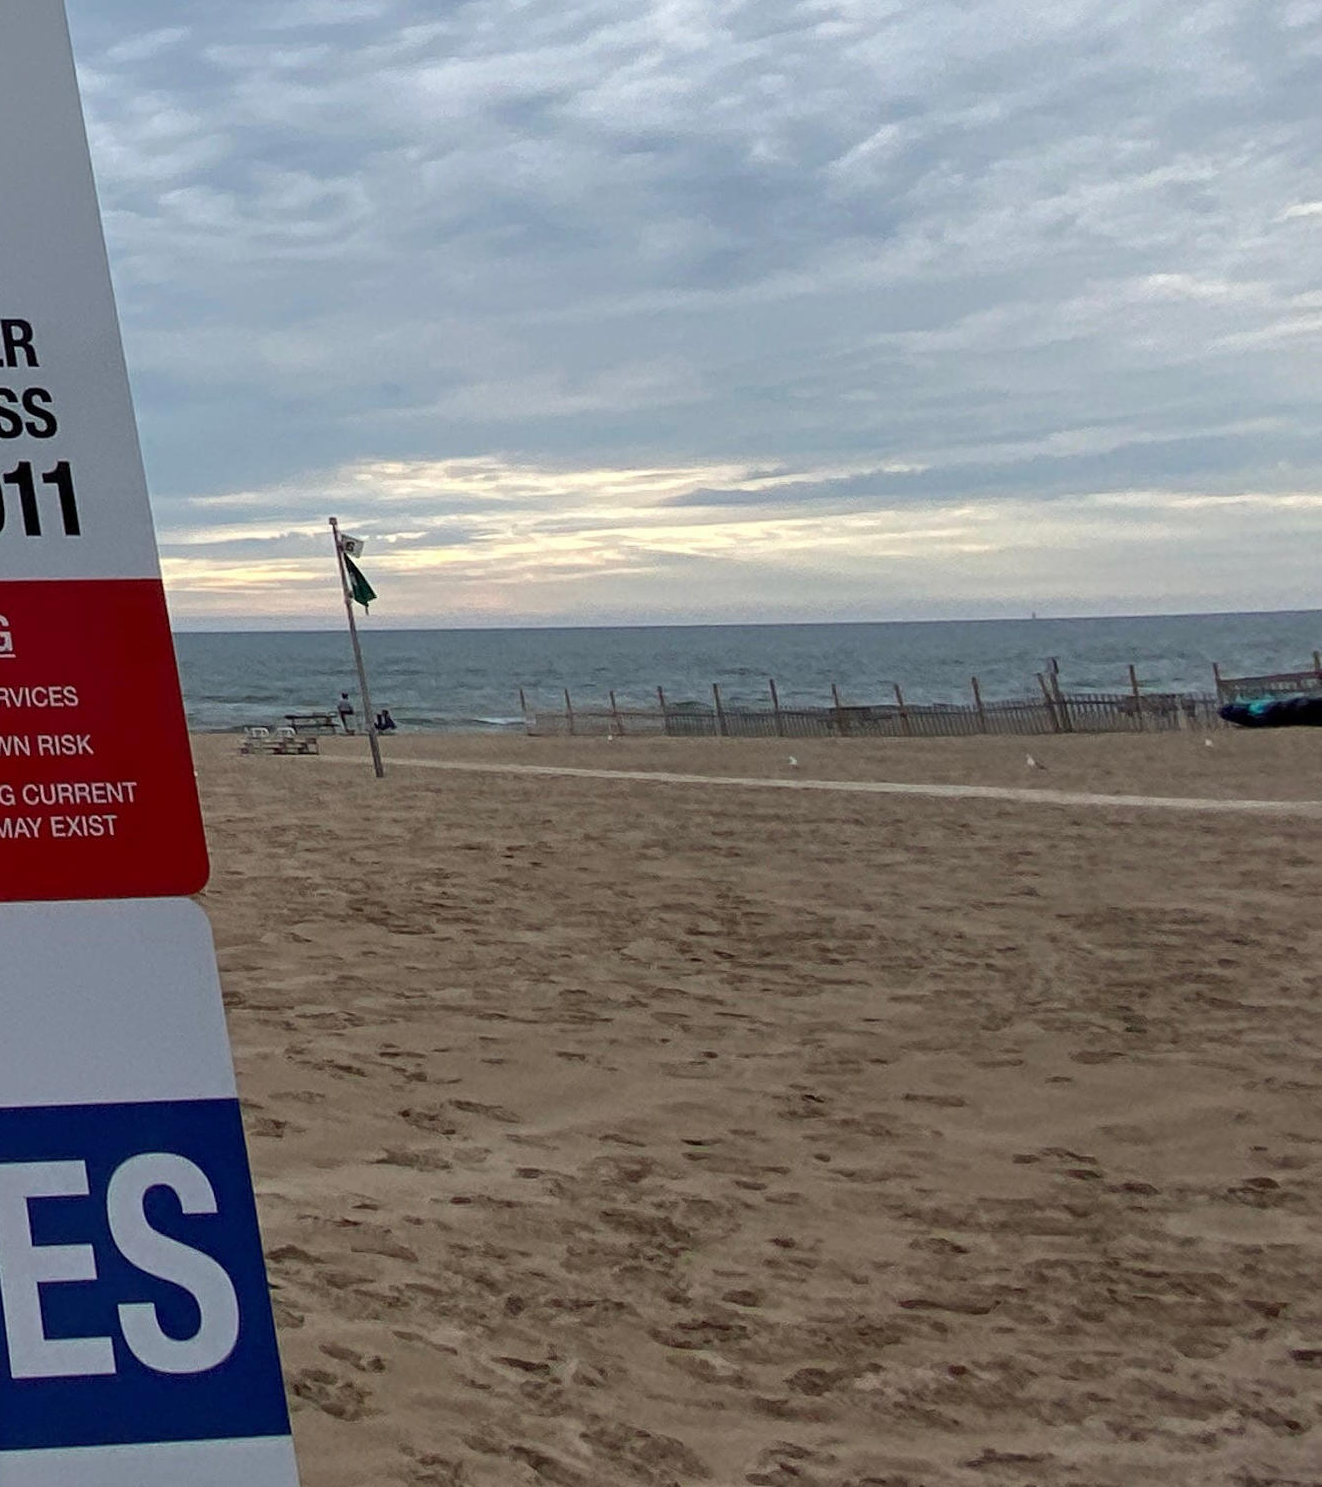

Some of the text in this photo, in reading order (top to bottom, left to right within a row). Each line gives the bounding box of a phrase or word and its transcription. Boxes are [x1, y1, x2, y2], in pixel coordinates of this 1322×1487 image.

[38, 735, 93, 755] RISK
[23, 782, 137, 805] CURRENT
[51, 815, 117, 837] EXIST
